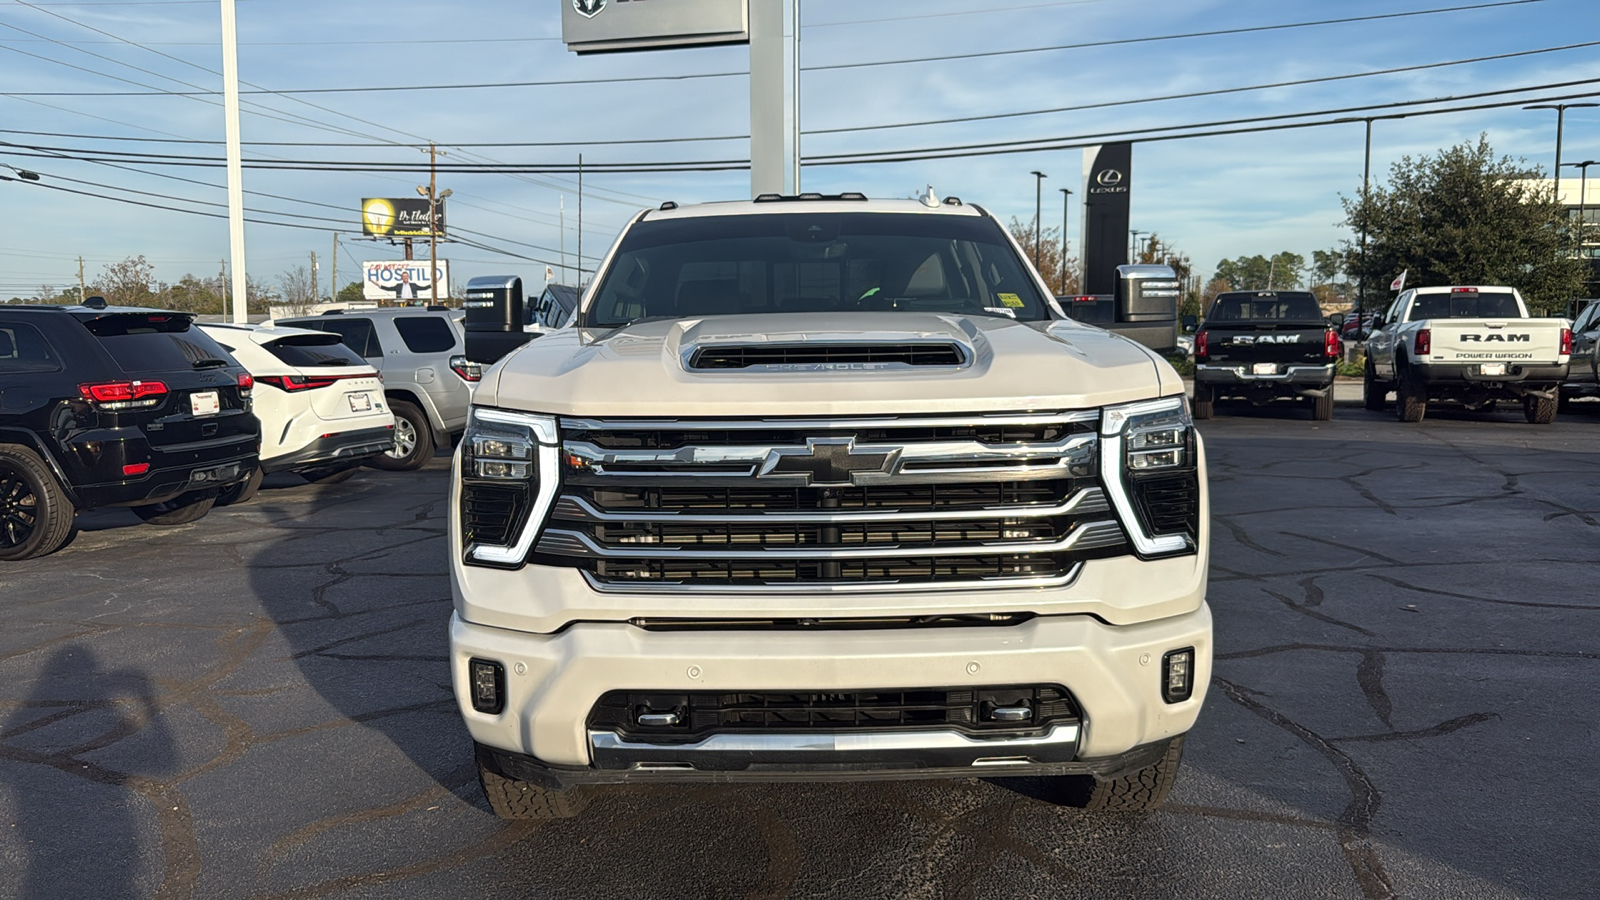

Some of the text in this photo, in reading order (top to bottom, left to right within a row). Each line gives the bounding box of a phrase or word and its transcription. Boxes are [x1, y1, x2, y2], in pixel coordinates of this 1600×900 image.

[399, 210, 410, 221] Dr
[1233, 334, 1300, 344] RAM
[1460, 334, 1530, 342] RAM
[766, 363, 889, 371] CHEVROLET
